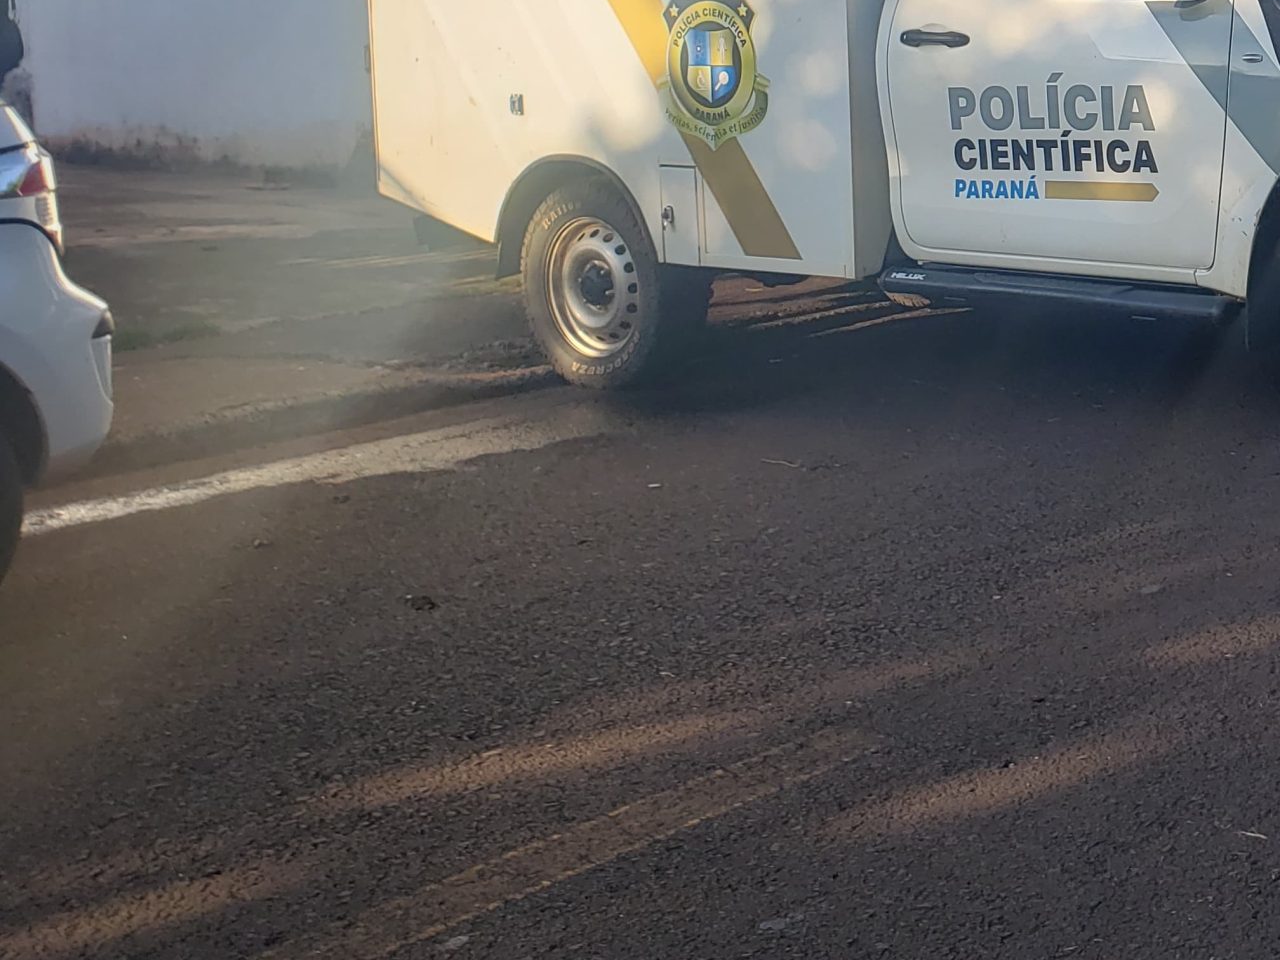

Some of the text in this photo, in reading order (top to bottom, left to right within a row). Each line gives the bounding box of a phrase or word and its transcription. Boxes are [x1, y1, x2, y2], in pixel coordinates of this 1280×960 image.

[672, 7, 747, 48] POLÍCIA CIENTÍFICA
[695, 107, 731, 121] PARANÁ
[948, 72, 1156, 131] POLÍCIA
[954, 130, 1159, 173] CIENTÍFICA
[955, 175, 1040, 199] PARANÁ
